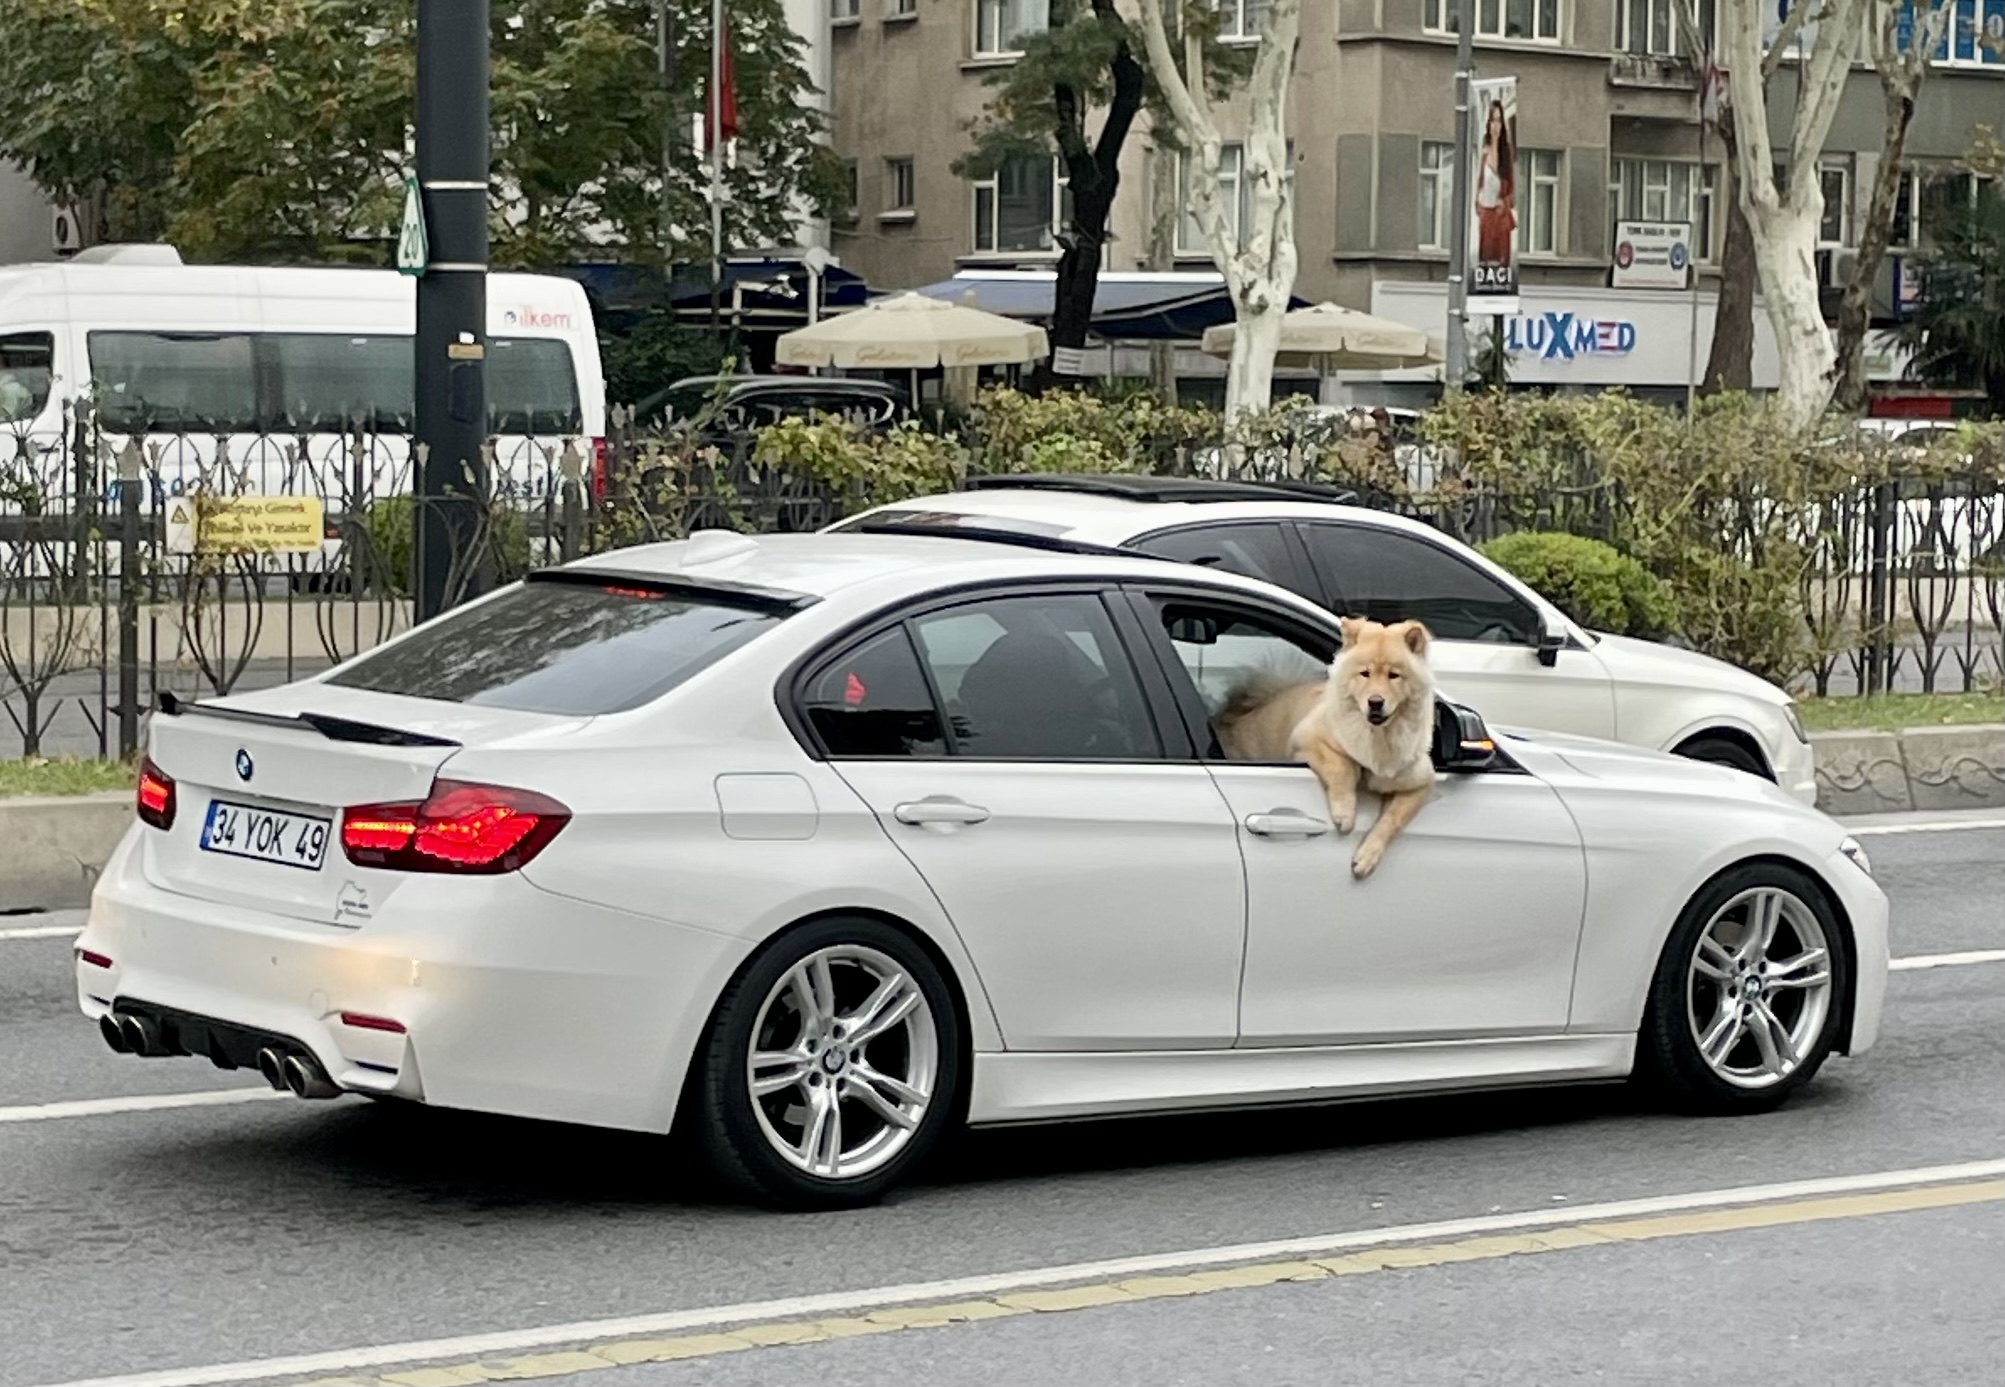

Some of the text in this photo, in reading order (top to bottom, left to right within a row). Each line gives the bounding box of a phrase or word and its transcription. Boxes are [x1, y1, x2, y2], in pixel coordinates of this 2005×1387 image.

[1508, 312, 1636, 359] LUXMED
[212, 808, 325, 862] 34 YOK 49
